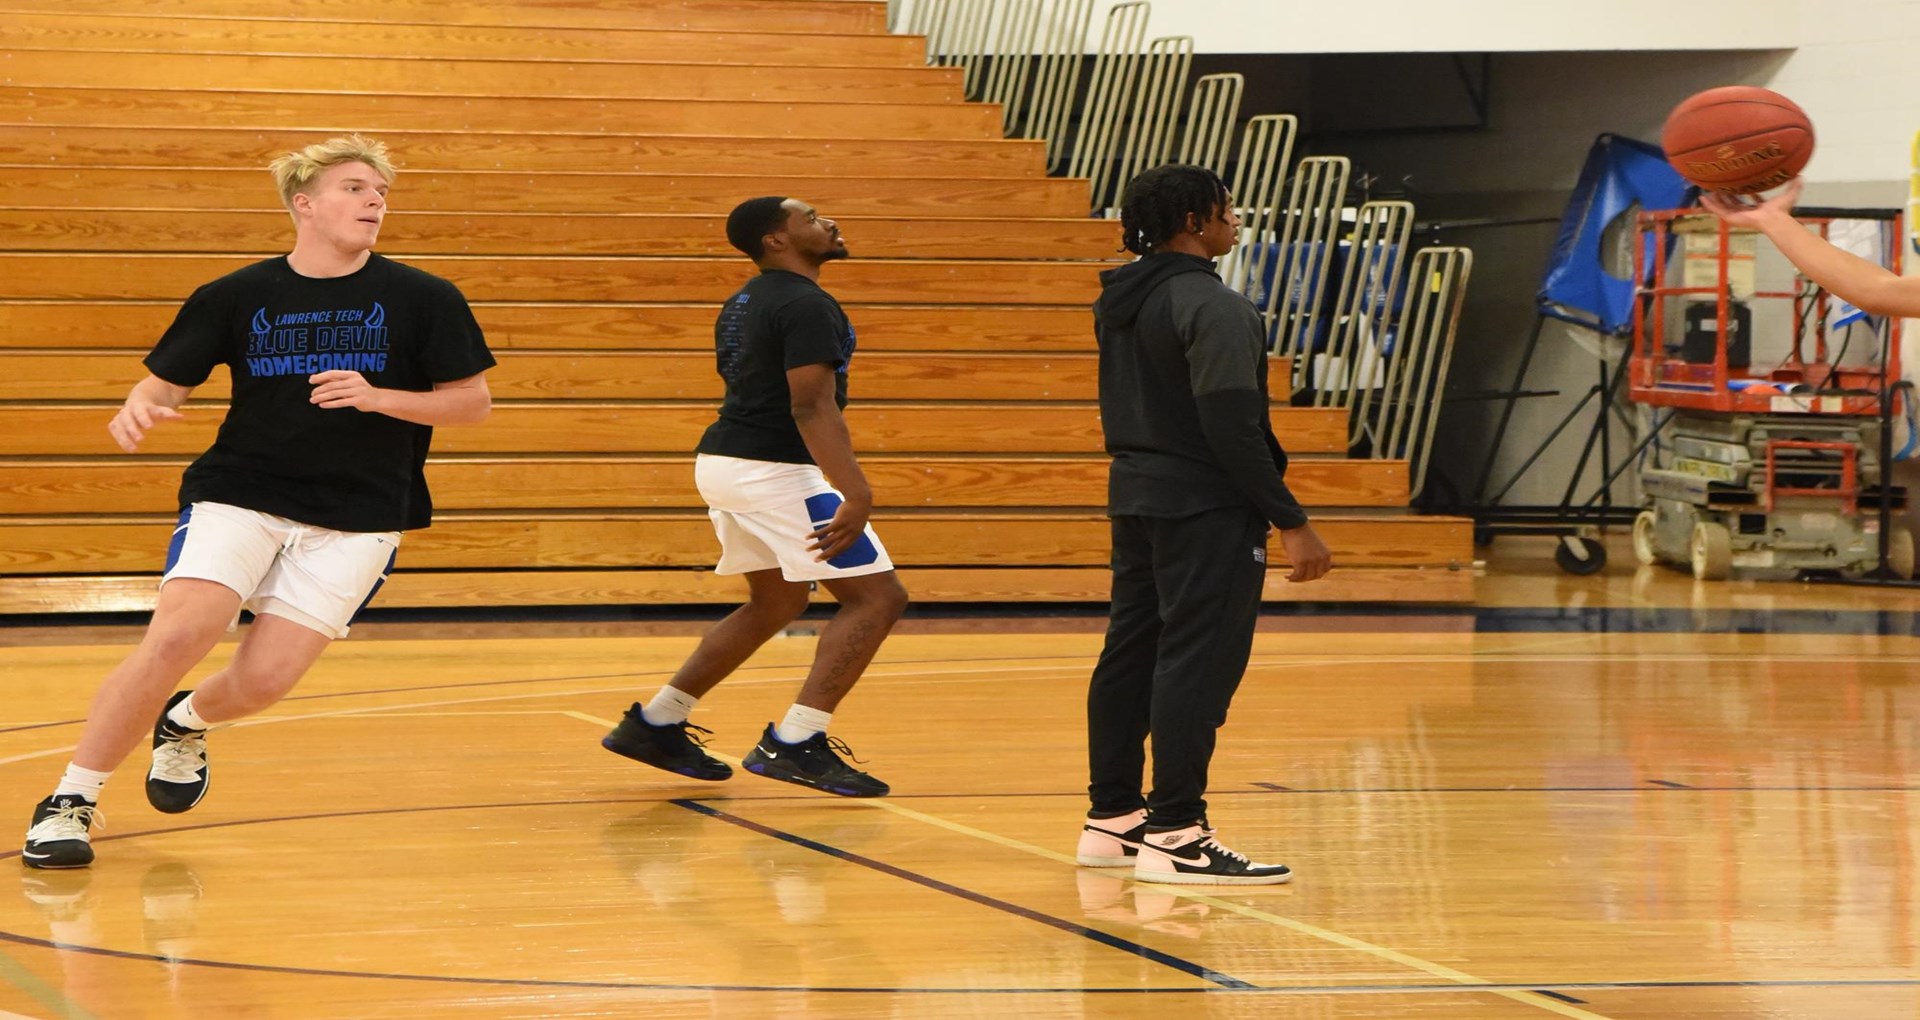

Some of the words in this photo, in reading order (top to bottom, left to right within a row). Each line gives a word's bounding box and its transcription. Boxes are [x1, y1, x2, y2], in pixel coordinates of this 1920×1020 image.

[275, 311, 333, 326] LAWRENCE
[335, 310, 364, 322] TECH
[246, 328, 308, 356] BLUE
[316, 325, 390, 352] DEVIL
[246, 353, 388, 377] HOMECOMING
